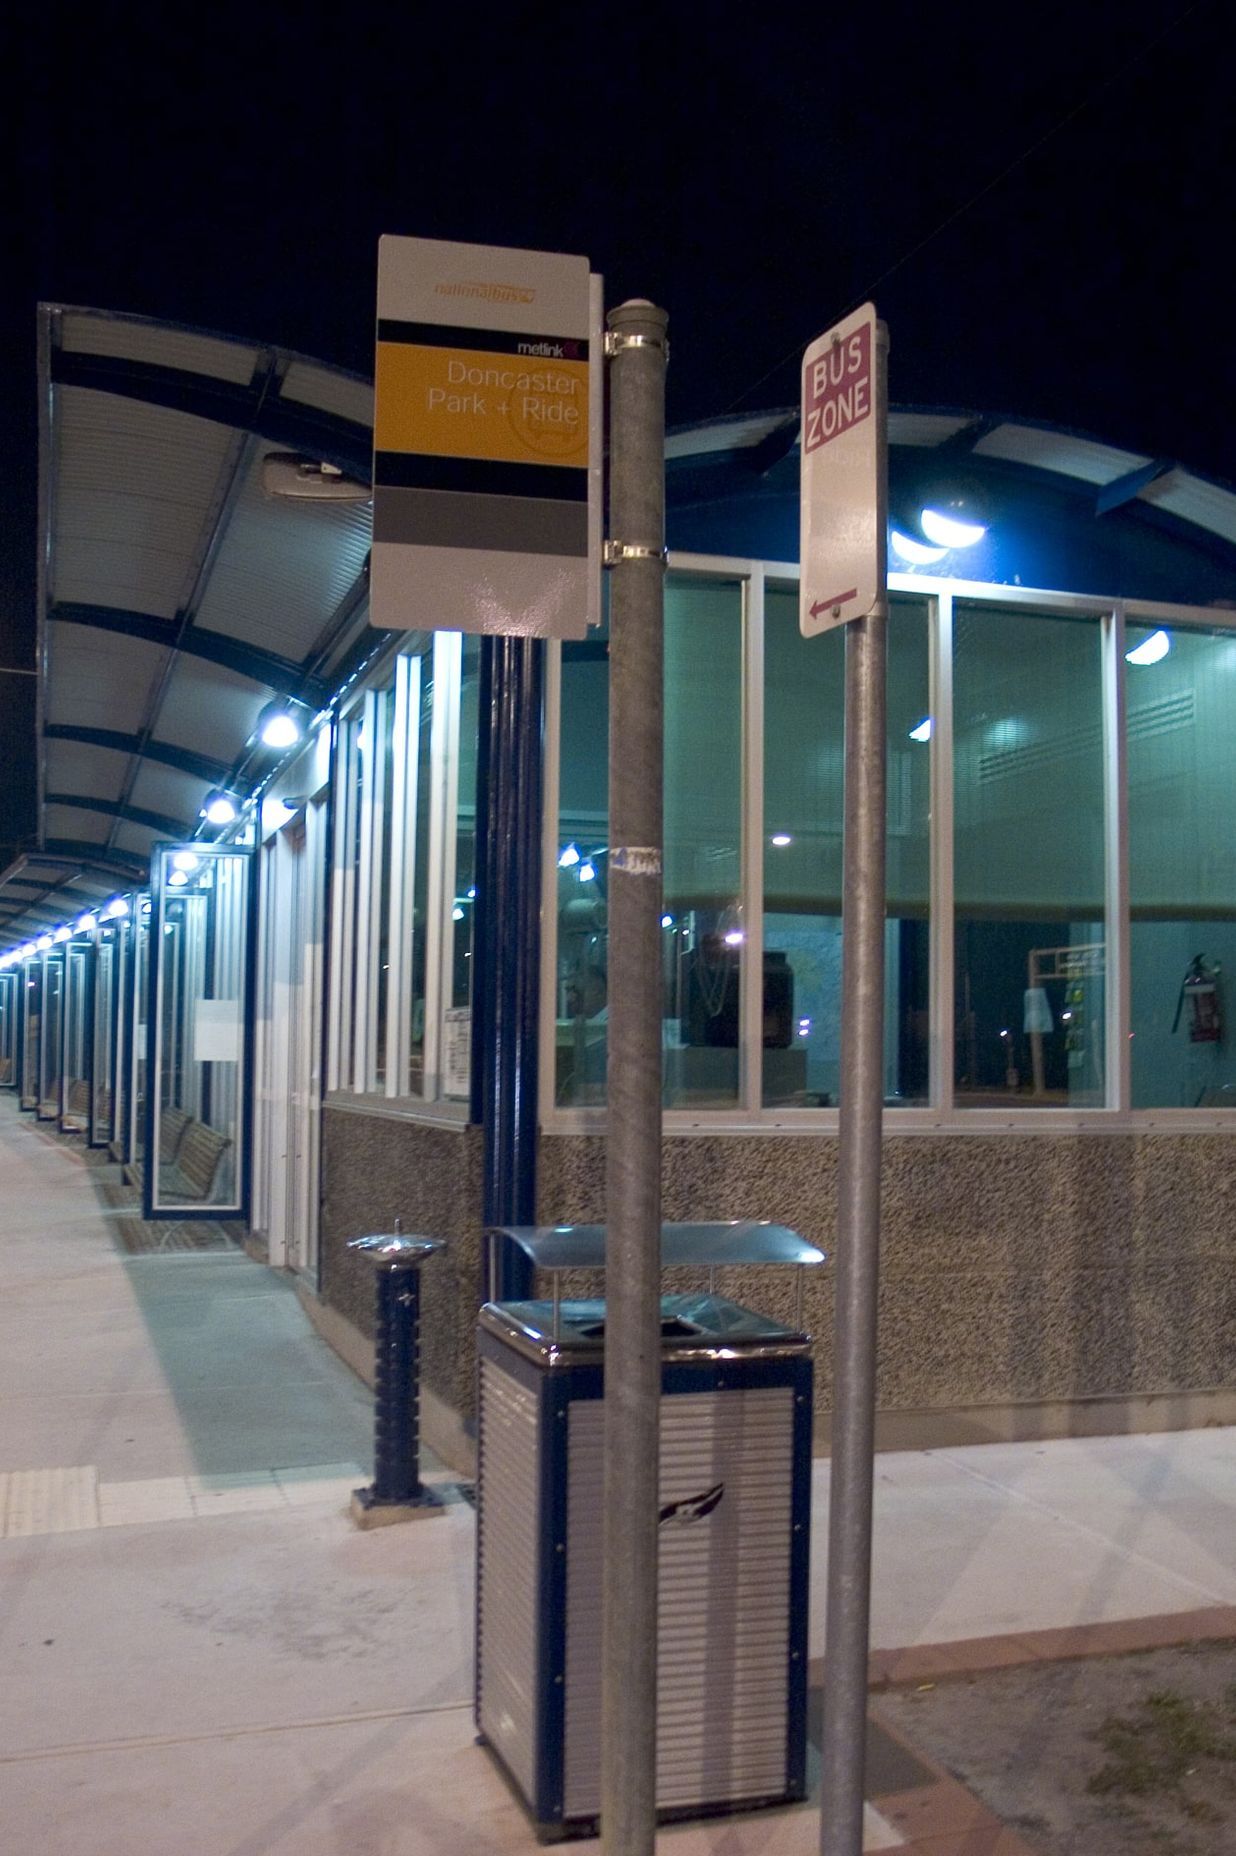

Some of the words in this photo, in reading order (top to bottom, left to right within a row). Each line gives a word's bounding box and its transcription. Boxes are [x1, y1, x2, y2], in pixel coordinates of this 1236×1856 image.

[517, 341, 564, 358] metlink
[813, 335, 862, 399] BUS
[448, 361, 580, 394] Doncaster
[428, 388, 486, 415] Park
[498, 401, 510, 415] +
[523, 396, 579, 425] Ride
[806, 376, 868, 448] ZONE
